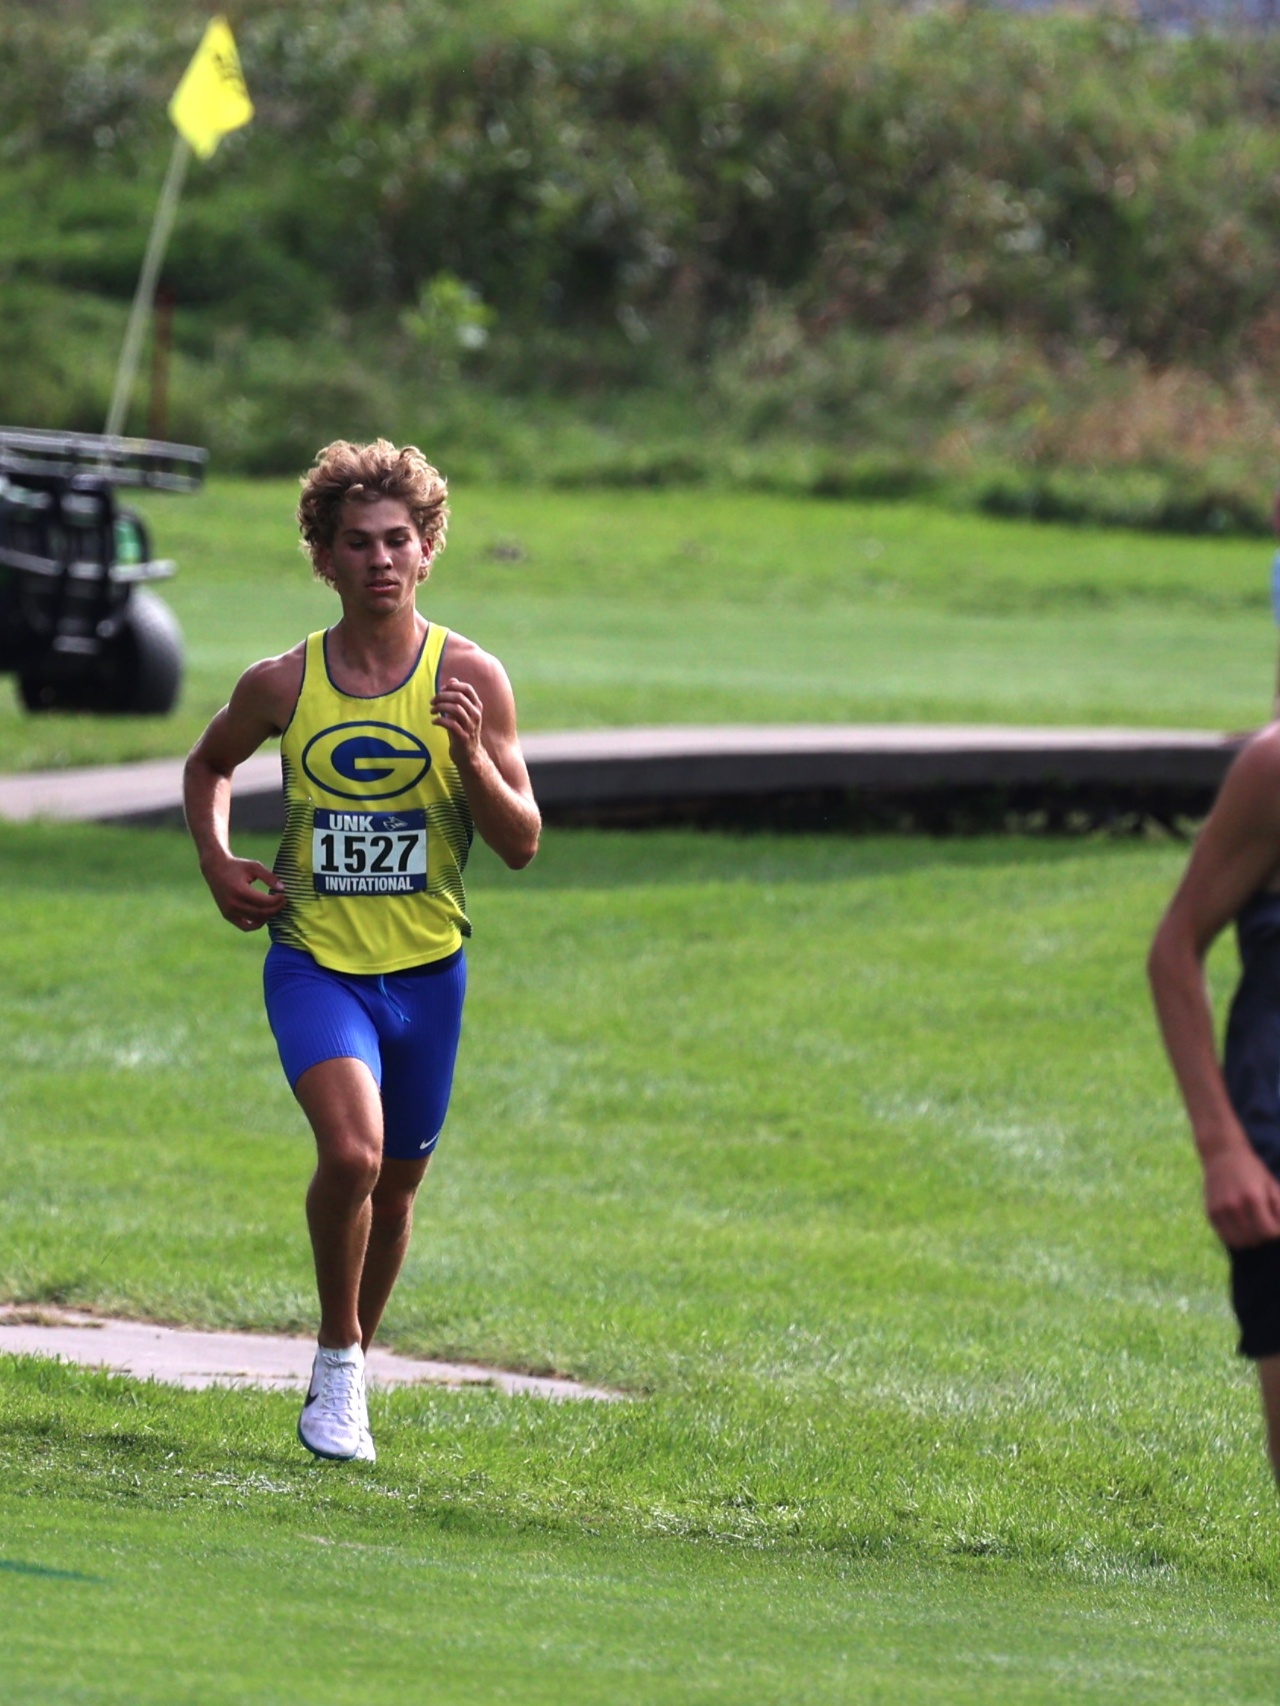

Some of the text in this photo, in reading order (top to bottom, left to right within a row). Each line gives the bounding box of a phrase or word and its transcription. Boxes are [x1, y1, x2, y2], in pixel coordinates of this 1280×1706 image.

[301, 720, 432, 801] G
[329, 813, 374, 832] UNK
[320, 833, 419, 874] 1527
[325, 876, 414, 893] INVITATIONAL
